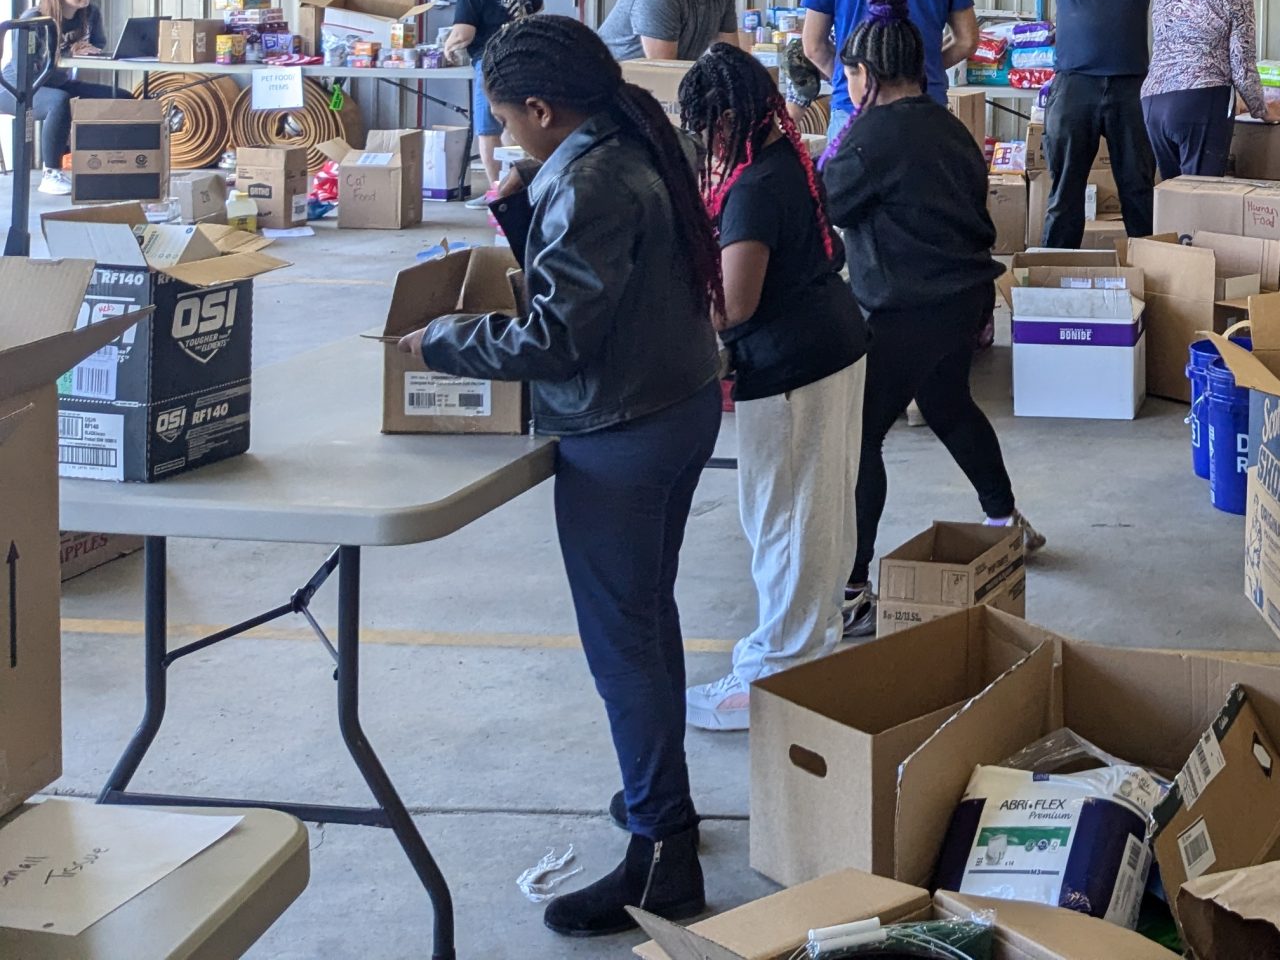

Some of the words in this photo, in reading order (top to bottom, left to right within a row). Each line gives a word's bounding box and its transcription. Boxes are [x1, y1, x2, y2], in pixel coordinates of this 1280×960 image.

[346, 174, 366, 187] Cat
[353, 188, 376, 202] Food
[1247, 201, 1279, 217] Human
[1253, 213, 1275, 228] Food
[102, 272, 144, 286] RF140
[172, 288, 238, 339] OSI
[185, 333, 218, 348] TOUGHER
[1059, 330, 1092, 341] BONIDE
[156, 407, 186, 434] OSI
[191, 402, 229, 426] RF140
[1028, 811, 1073, 821] Premium
[45, 846, 110, 884] Tissue
